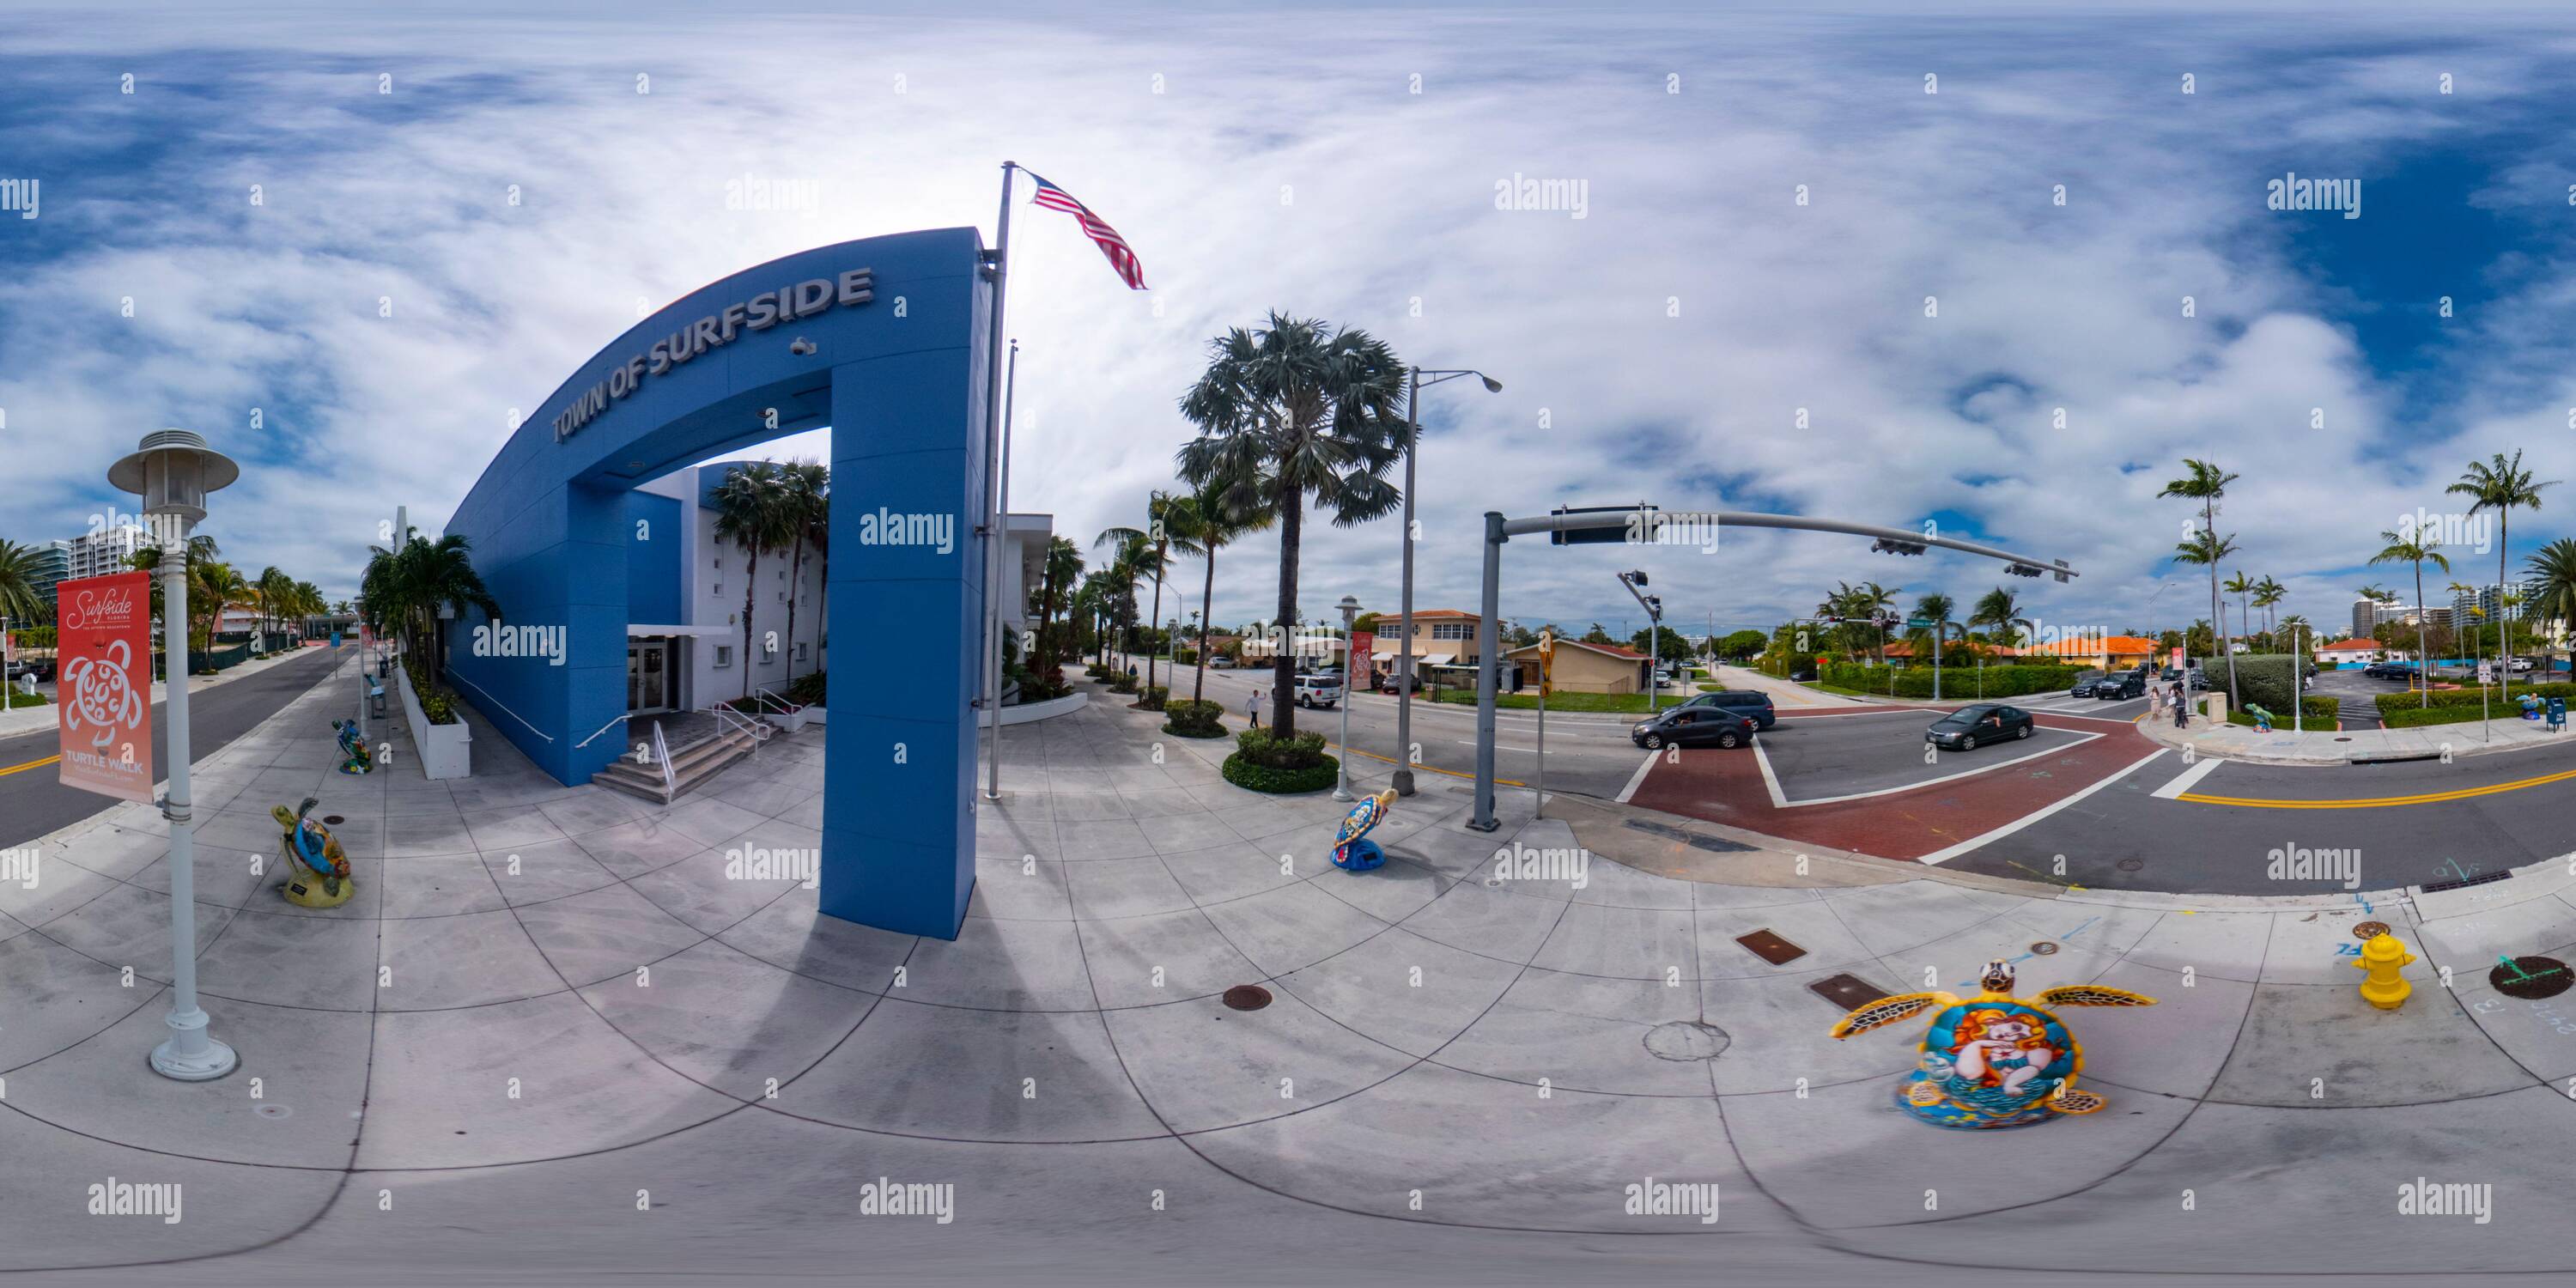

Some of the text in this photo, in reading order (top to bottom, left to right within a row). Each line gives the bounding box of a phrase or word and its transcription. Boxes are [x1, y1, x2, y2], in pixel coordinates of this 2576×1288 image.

[551, 267, 874, 444] TOWN OF SURFSIDE
[66, 587, 132, 629] Surfside
[66, 750, 143, 775] TURTLE WALK
